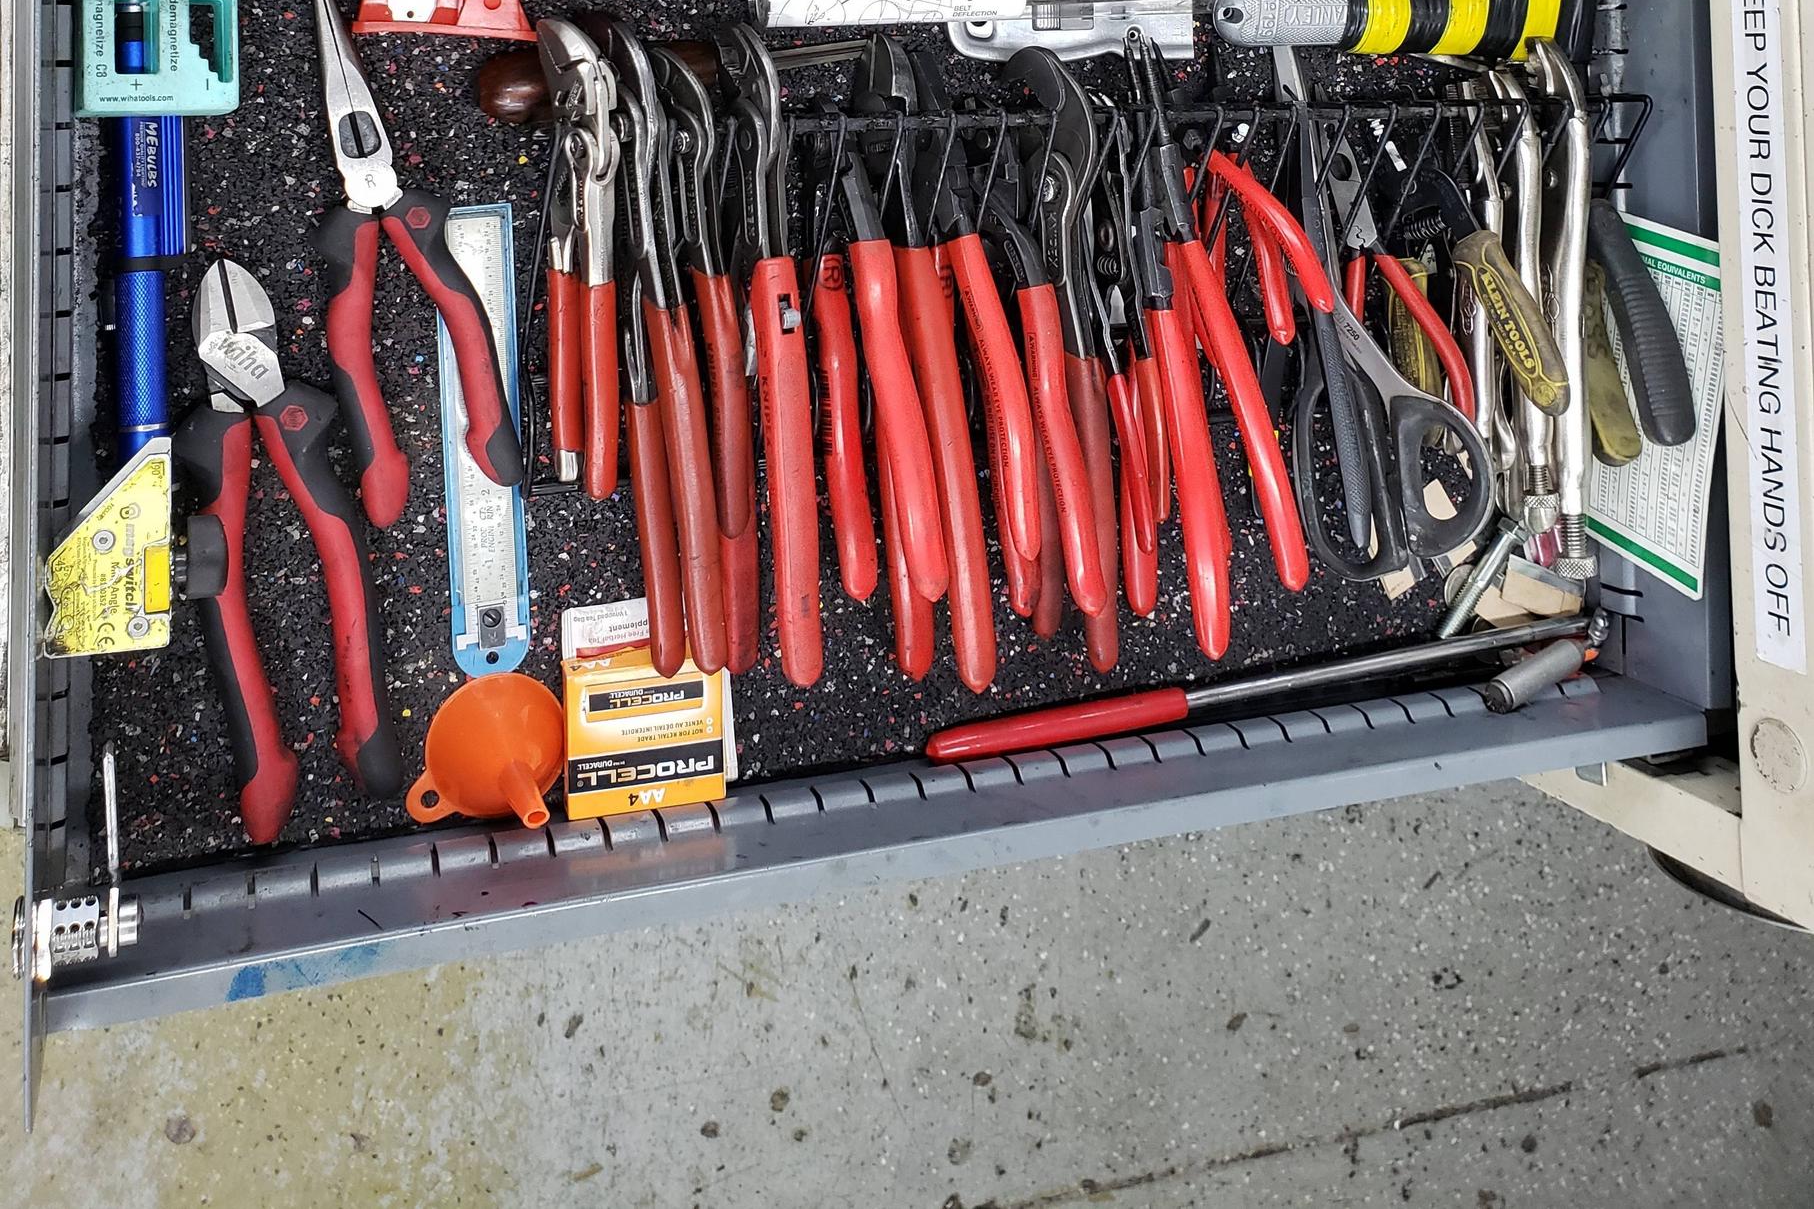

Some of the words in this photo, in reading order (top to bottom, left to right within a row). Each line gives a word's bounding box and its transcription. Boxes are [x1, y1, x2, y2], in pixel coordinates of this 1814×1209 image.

[1288, 4, 1348, 27] ANLEY
[99, 94, 174, 103] www.wihatools.com
[1744, 63, 1771, 161] YOUR
[146, 122, 159, 188] MEBULBS
[1750, 174, 1774, 254] DICK
[1657, 261, 1706, 284] EQUIVALENTS
[1481, 272, 1509, 319] KLEIN
[1504, 320, 1535, 368] TOOLS
[1752, 267, 1783, 416] BEATING
[979, 338, 994, 371] ALWAYS
[1029, 341, 1038, 378] WARNING
[988, 373, 999, 398] WEAR
[762, 376, 772, 448] KNIPEX
[994, 399, 1002, 414] EYE
[1033, 387, 1044, 420] ALWAYS
[997, 416, 1009, 468] PROTECTION
[1039, 422, 1049, 446] WEAR
[990, 443, 996, 453] ON
[1044, 447, 1053, 462] EYE
[1050, 463, 1067, 513] PROTECTION
[1759, 429, 1788, 554] HANDS
[109, 587, 120, 614] Angle
[1766, 563, 1791, 638] OFF
[609, 619, 648, 633] pplement
[588, 637, 601, 645] Tea
[609, 690, 684, 708] PROCELL
[621, 726, 652, 735] INTERDITE
[654, 724, 674, 732] DÉTAIL
[658, 731, 677, 739] RETAIL
[685, 719, 703, 727] VENTE
[578, 759, 613, 771] DURACELL
[578, 755, 715, 787] PROCELL
